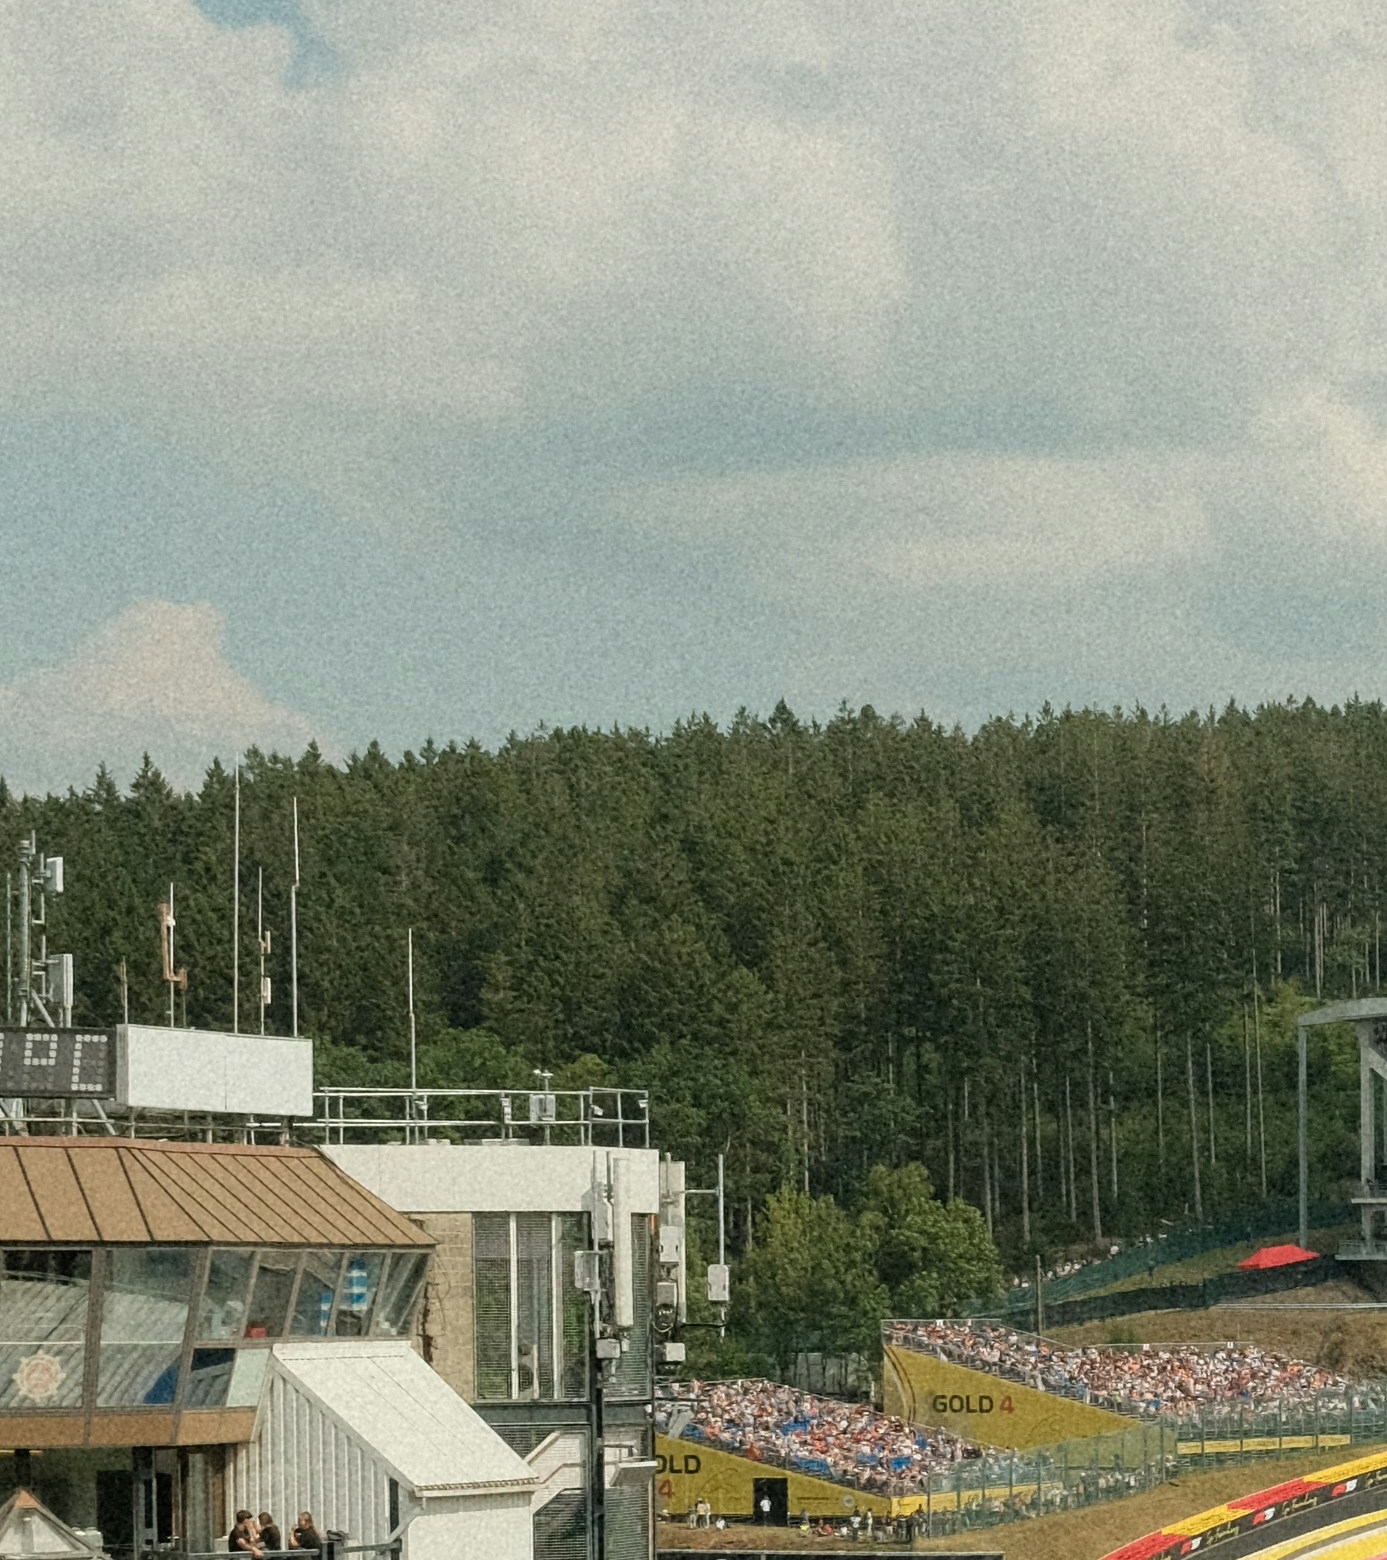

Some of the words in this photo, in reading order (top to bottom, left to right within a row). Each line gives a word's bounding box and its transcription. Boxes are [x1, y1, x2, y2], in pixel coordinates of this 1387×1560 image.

[932, 1394, 994, 1414] GOLD
[999, 1394, 1015, 1414] 4
[658, 1478, 675, 1499] 4
